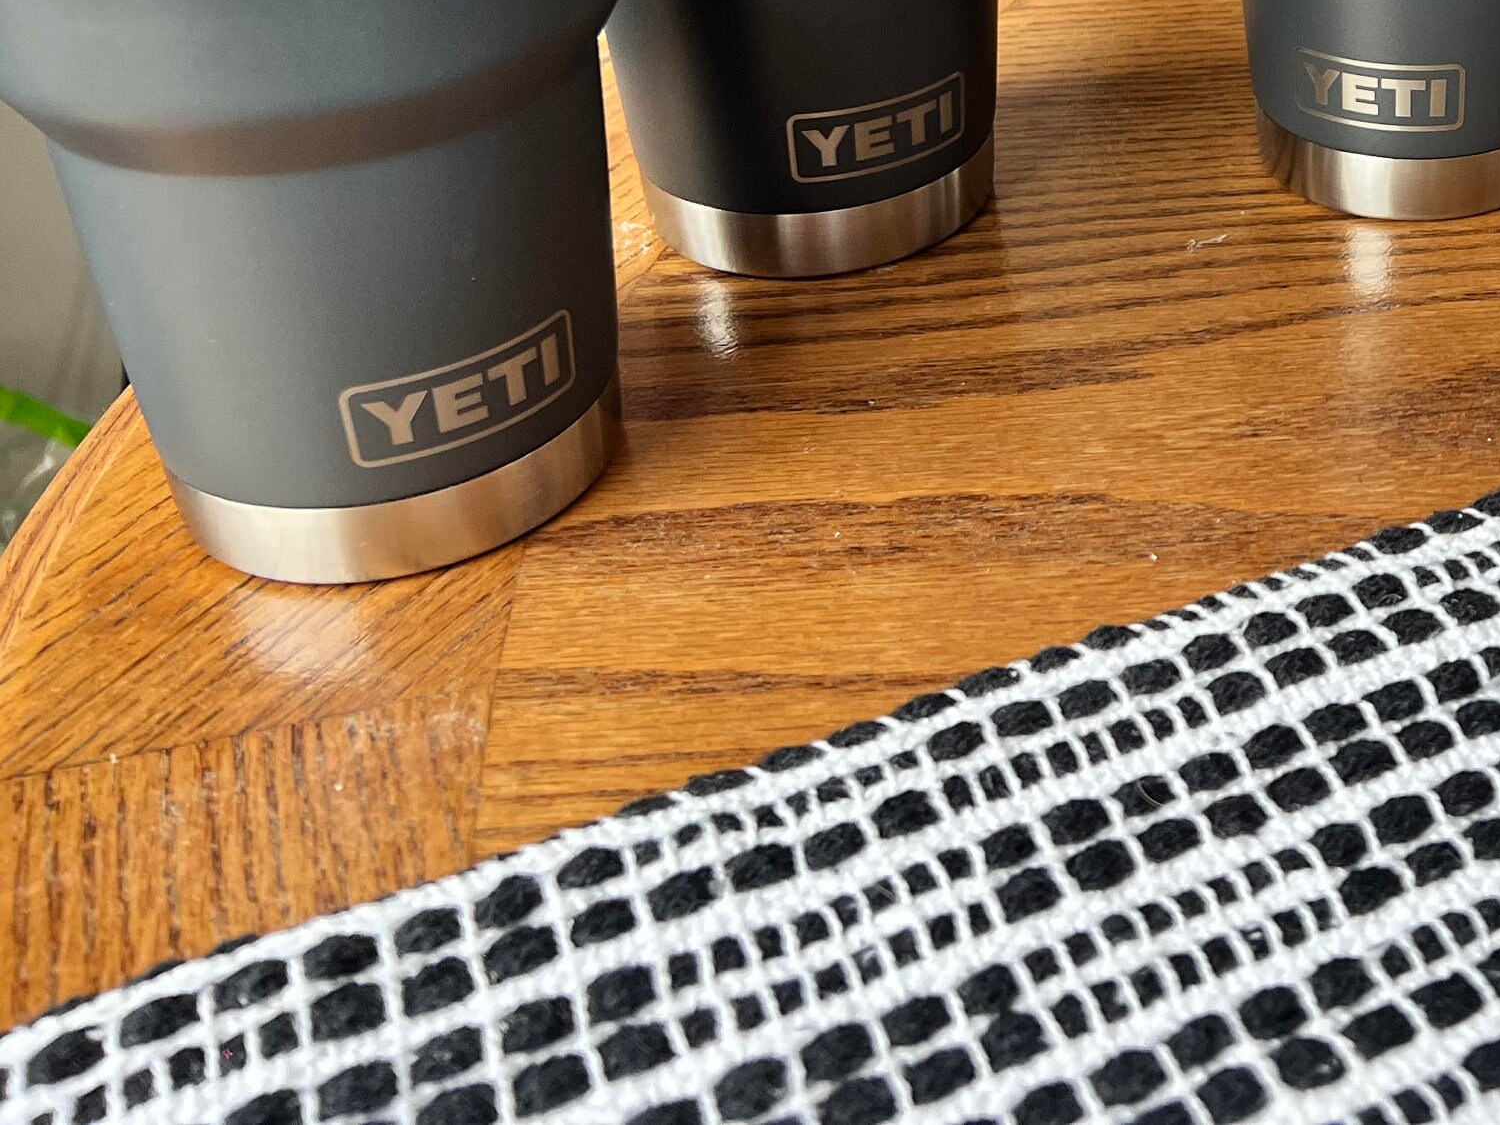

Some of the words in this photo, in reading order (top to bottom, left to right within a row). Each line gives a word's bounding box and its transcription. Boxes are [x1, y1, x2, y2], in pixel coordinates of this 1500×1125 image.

[1302, 60, 1447, 118] YETI
[800, 90, 954, 167] YETI
[360, 333, 562, 446] YETI
